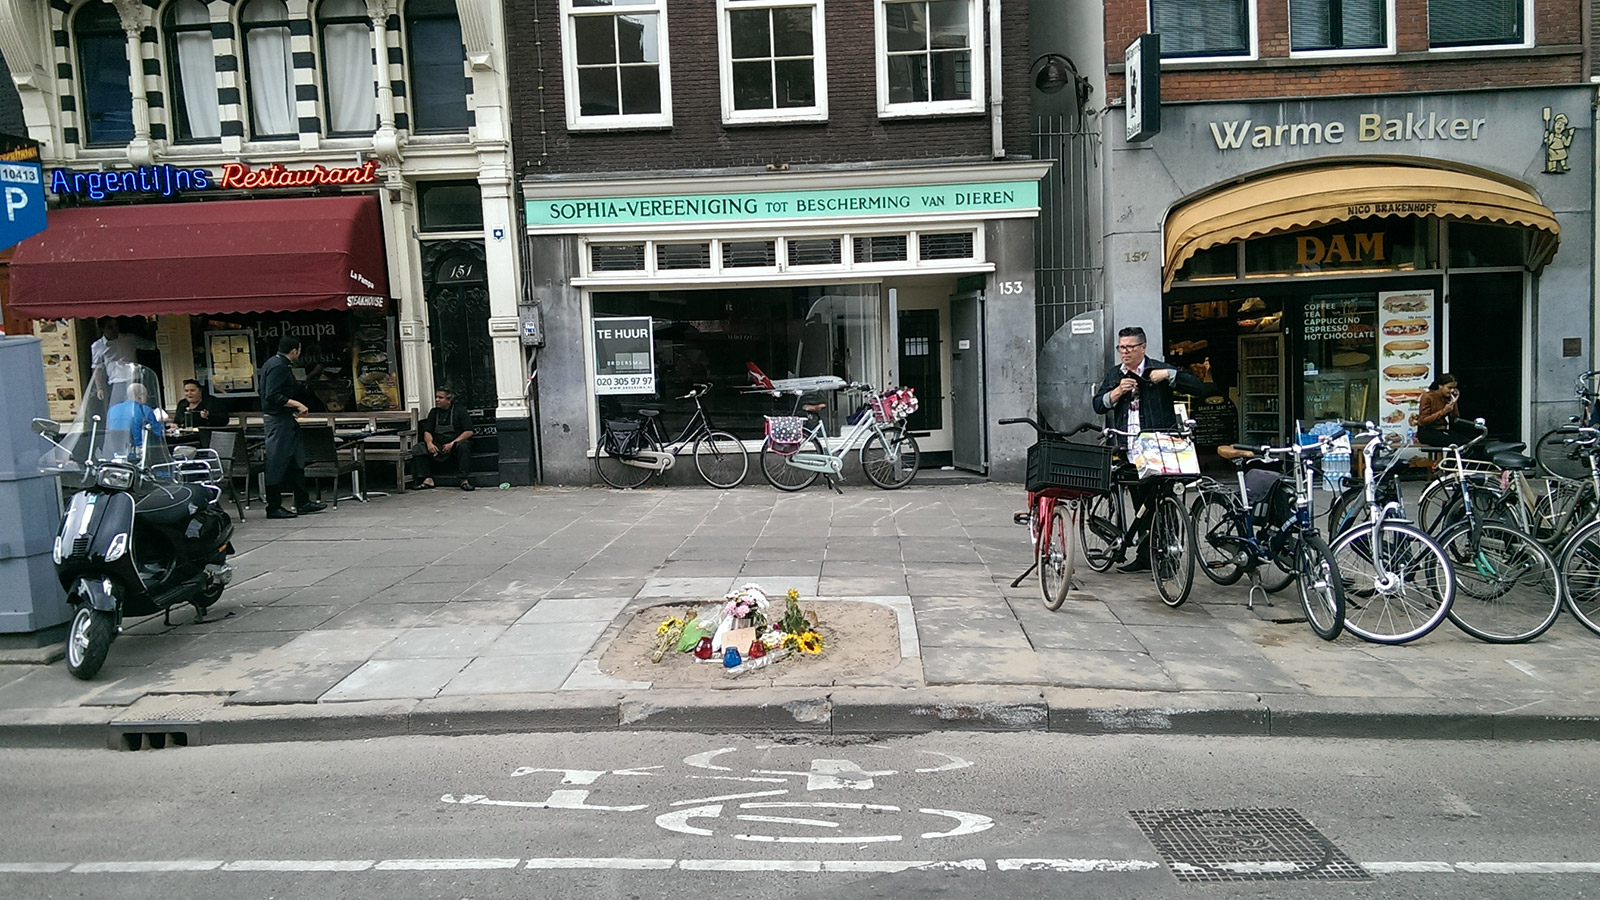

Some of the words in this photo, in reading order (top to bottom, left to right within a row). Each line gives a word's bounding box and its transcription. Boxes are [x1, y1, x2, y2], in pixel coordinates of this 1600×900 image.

[1209, 120, 1345, 150] Warme
[1359, 112, 1486, 142] Bakker
[2, 168, 36, 181] 10413
[221, 162, 375, 188] Restaurant
[5, 187, 28, 222] P
[549, 198, 758, 220] SOPHIA-VEREENIGING
[765, 201, 789, 213] TOT
[796, 195, 911, 213] BESCHERMING
[921, 195, 945, 207] VAN
[955, 190, 1015, 206] DIEREN
[1347, 205, 1371, 216] NICO
[1375, 203, 1437, 213] BRAKENHOFF
[1296, 232, 1385, 264] DAM
[1124, 251, 1149, 262] 157
[450, 264, 472, 278] 151
[350, 269, 358, 280] La
[358, 273, 375, 289] Pampa
[999, 281, 1023, 294] 153
[346, 295, 384, 307] STEAKHOUSE
[1303, 302, 1336, 311] COFFEE
[1303, 316, 1360, 326] CAPPUCCINO
[1304, 311, 1321, 319] TEA
[256, 320, 279, 338] La
[280, 320, 336, 341] Pampa
[597, 329, 612, 339] TE
[614, 328, 648, 339] HUUR
[1303, 333, 1321, 341] HOT
[1323, 331, 1375, 340] CHOCOLATE
[1304, 325, 1349, 334] ESPRESSO
[596, 378, 612, 386] 020
[614, 377, 629, 386] 305
[630, 377, 641, 385] 97
[642, 376, 652, 385] 97
